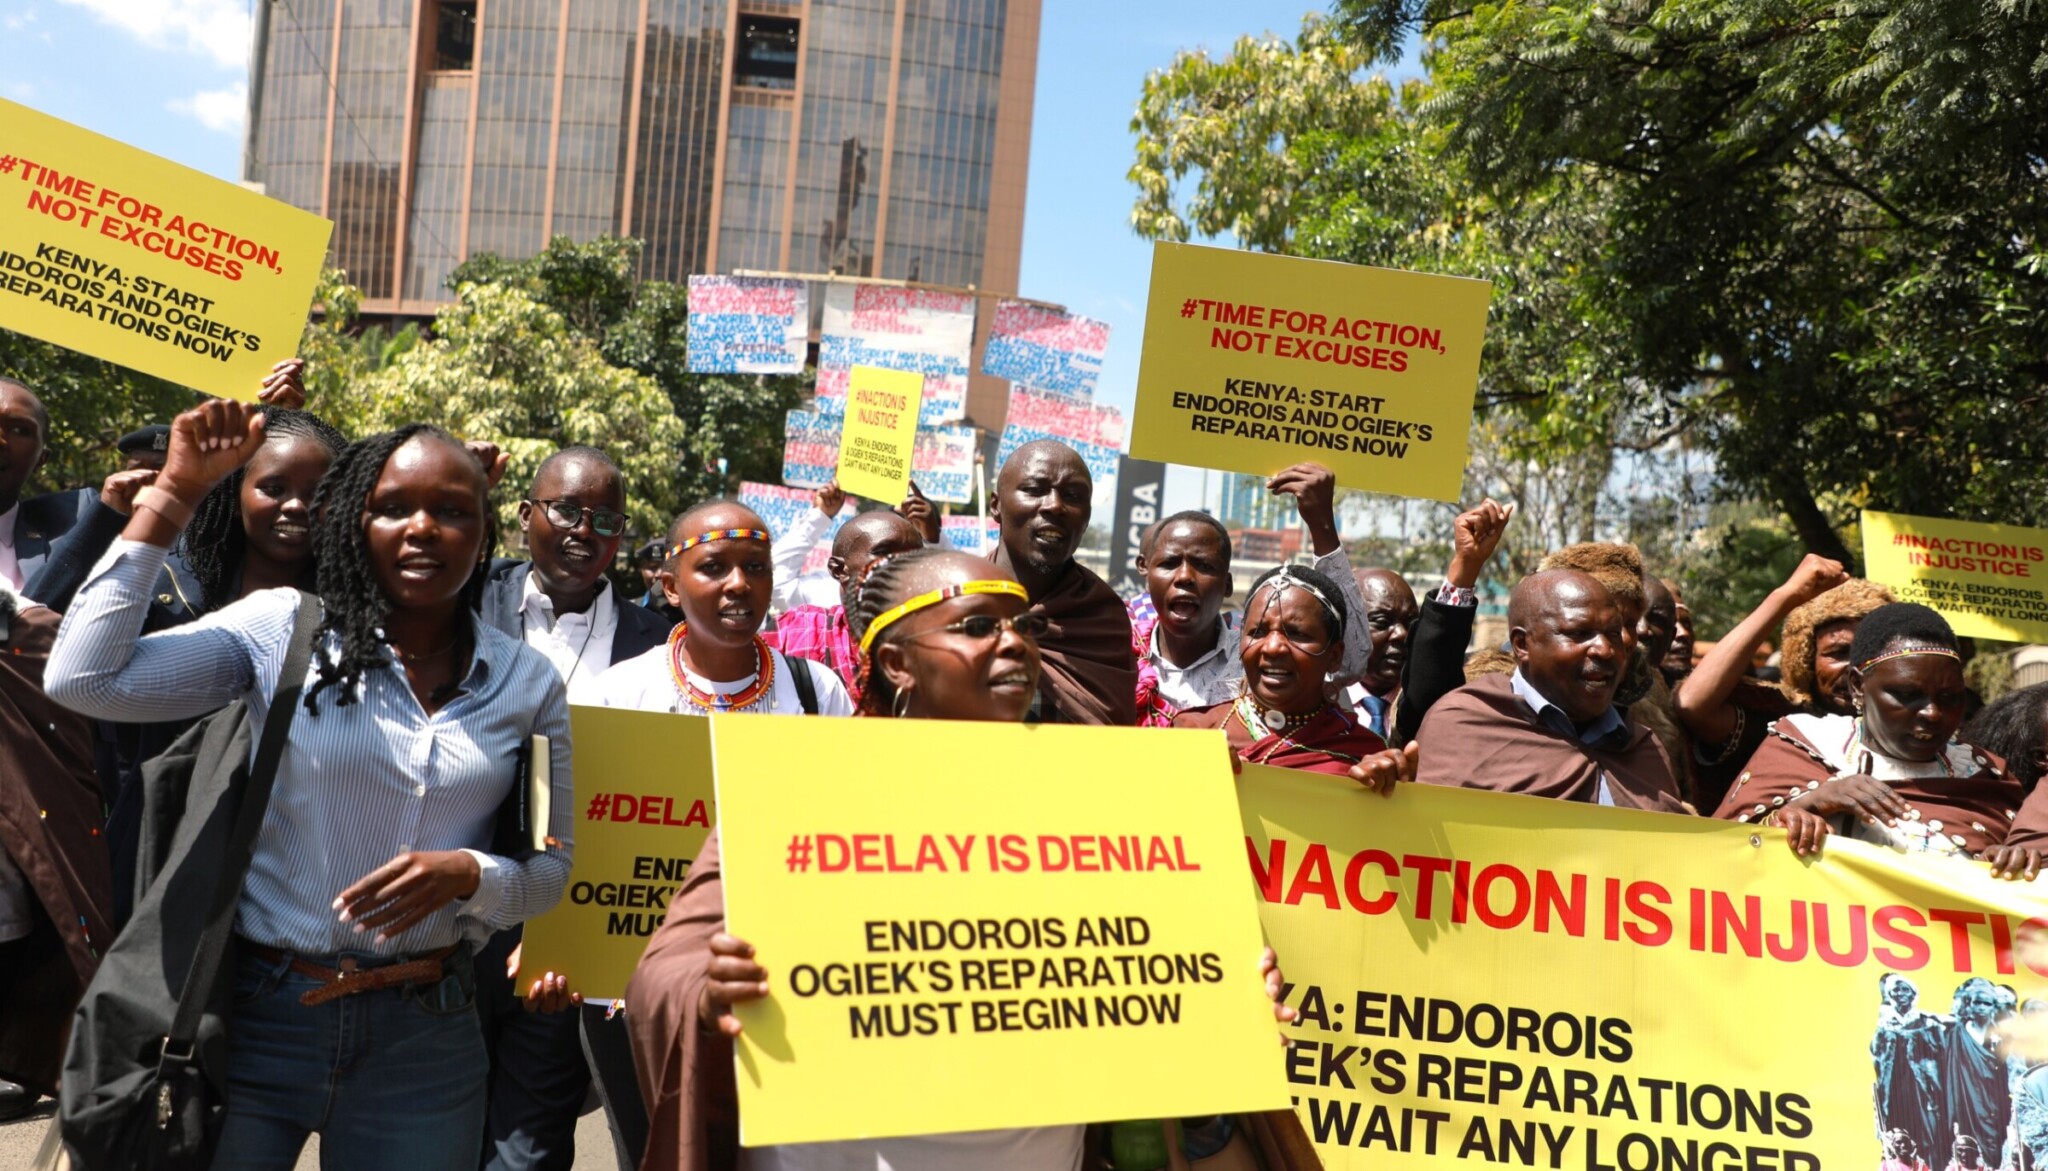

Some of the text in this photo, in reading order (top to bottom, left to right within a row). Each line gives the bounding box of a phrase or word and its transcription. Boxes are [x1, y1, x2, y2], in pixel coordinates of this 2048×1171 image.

[0, 154, 283, 275] #TIME FOR ACTION,
[27, 189, 244, 281] NOT EXCUSES
[36, 241, 215, 315] KENYA: START
[0, 250, 261, 353] DOROIS AND OGIEK'S
[1181, 298, 1447, 356] #TIME FOR ACTION,
[173, 333, 234, 362] NOW
[1211, 327, 1409, 373] NOT EXCUSES
[856, 388, 897, 411] #INACTION
[898, 395, 907, 412] IS
[1224, 378, 1385, 414] KENYA: START
[858, 407, 898, 430] INJUSTICE
[1172, 391, 1434, 442] ENDOROIS AND OGIEK'S
[872, 441, 897, 455] ENDOROIS
[1191, 415, 1409, 459] REPARATIONS NOW
[869, 450, 903, 470] REPARATIONS
[870, 465, 881, 475] ANY
[881, 467, 902, 481] LONGER
[1893, 533, 2045, 562] #INACTION IS
[1908, 552, 2031, 577] INJUSTICE
[1902, 587, 1960, 602] OGIEK'S
[1963, 593, 2048, 611] REPARATIO
[1911, 577, 2044, 600] KENYA: ENDOROIS
[1935, 601, 1971, 613] WAIT
[1976, 606, 2006, 618] ANY
[587, 792, 717, 828] #DELA
[786, 833, 1200, 874] #DELAY IS DENIAL
[570, 880, 677, 909] OGIEK'
[1604, 877, 1674, 948] IS
[864, 916, 1151, 953] ENDOROIS AND
[789, 953, 1223, 998] OGIEK'S REPARATIONS
[849, 994, 1182, 1039] MUST BEGIN NOW
[1354, 990, 1633, 1064] ENDOROIS
[1416, 1053, 1813, 1139] REPARATIONS
[1308, 1096, 1450, 1156] WAIT
[1456, 1115, 1576, 1169] ANY
